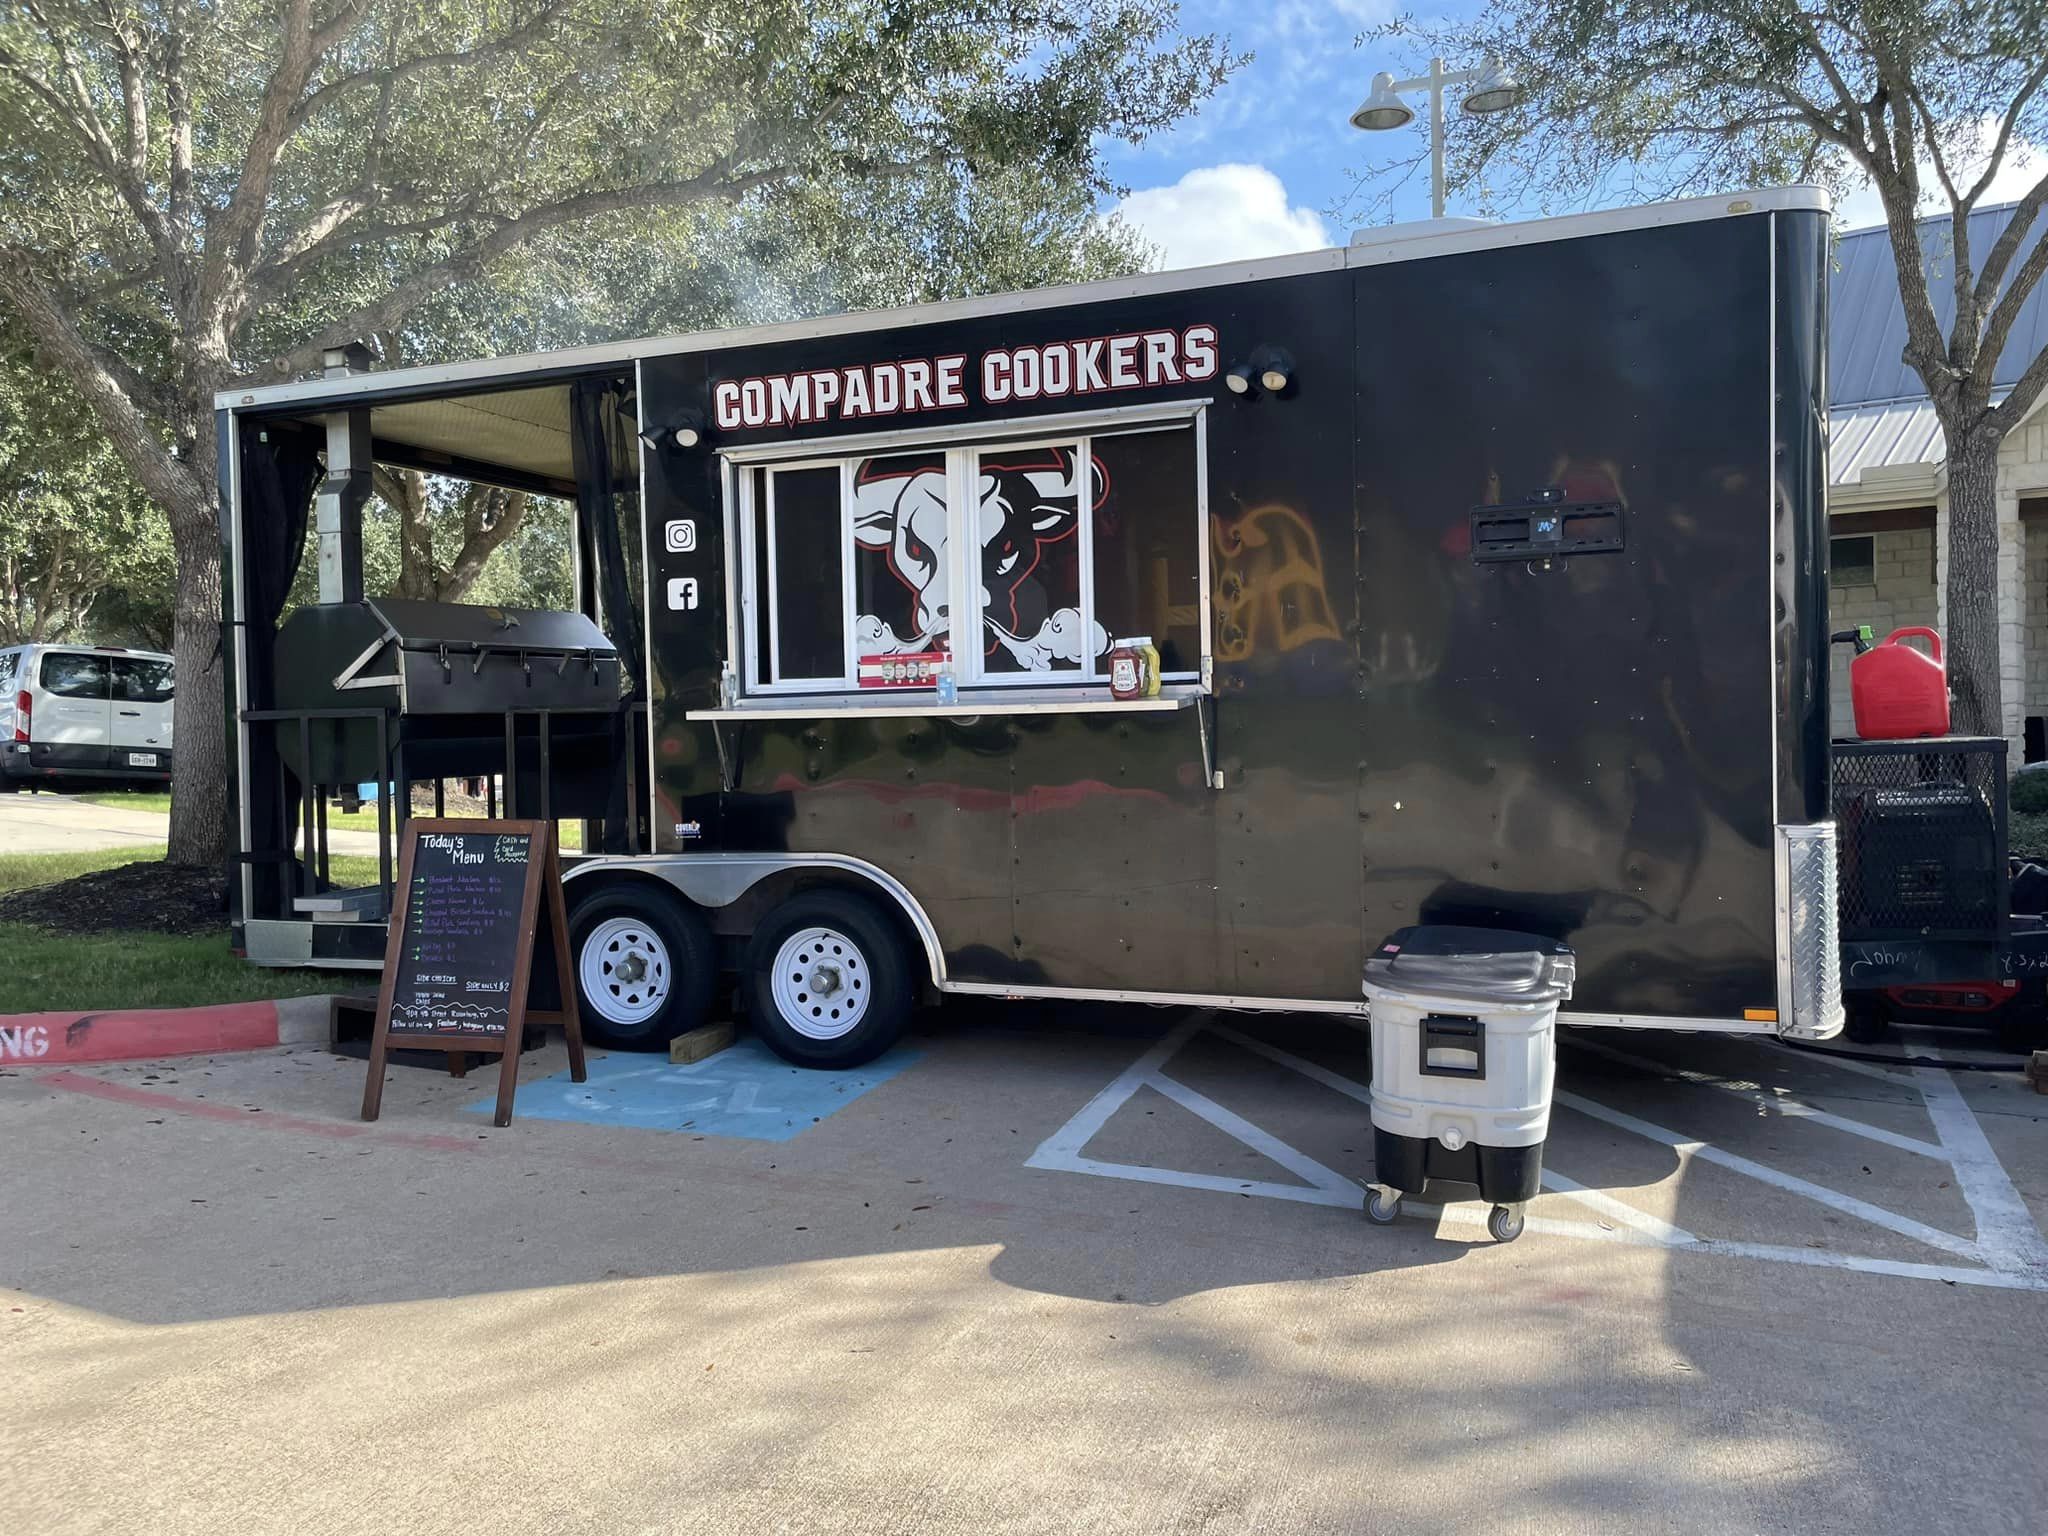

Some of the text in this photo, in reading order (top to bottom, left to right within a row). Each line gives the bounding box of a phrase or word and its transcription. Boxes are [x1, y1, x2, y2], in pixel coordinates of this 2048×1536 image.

[714, 325, 1218, 431] COMPADRE COOKERS
[420, 834, 464, 854] Today's
[452, 849, 485, 865] Menu
